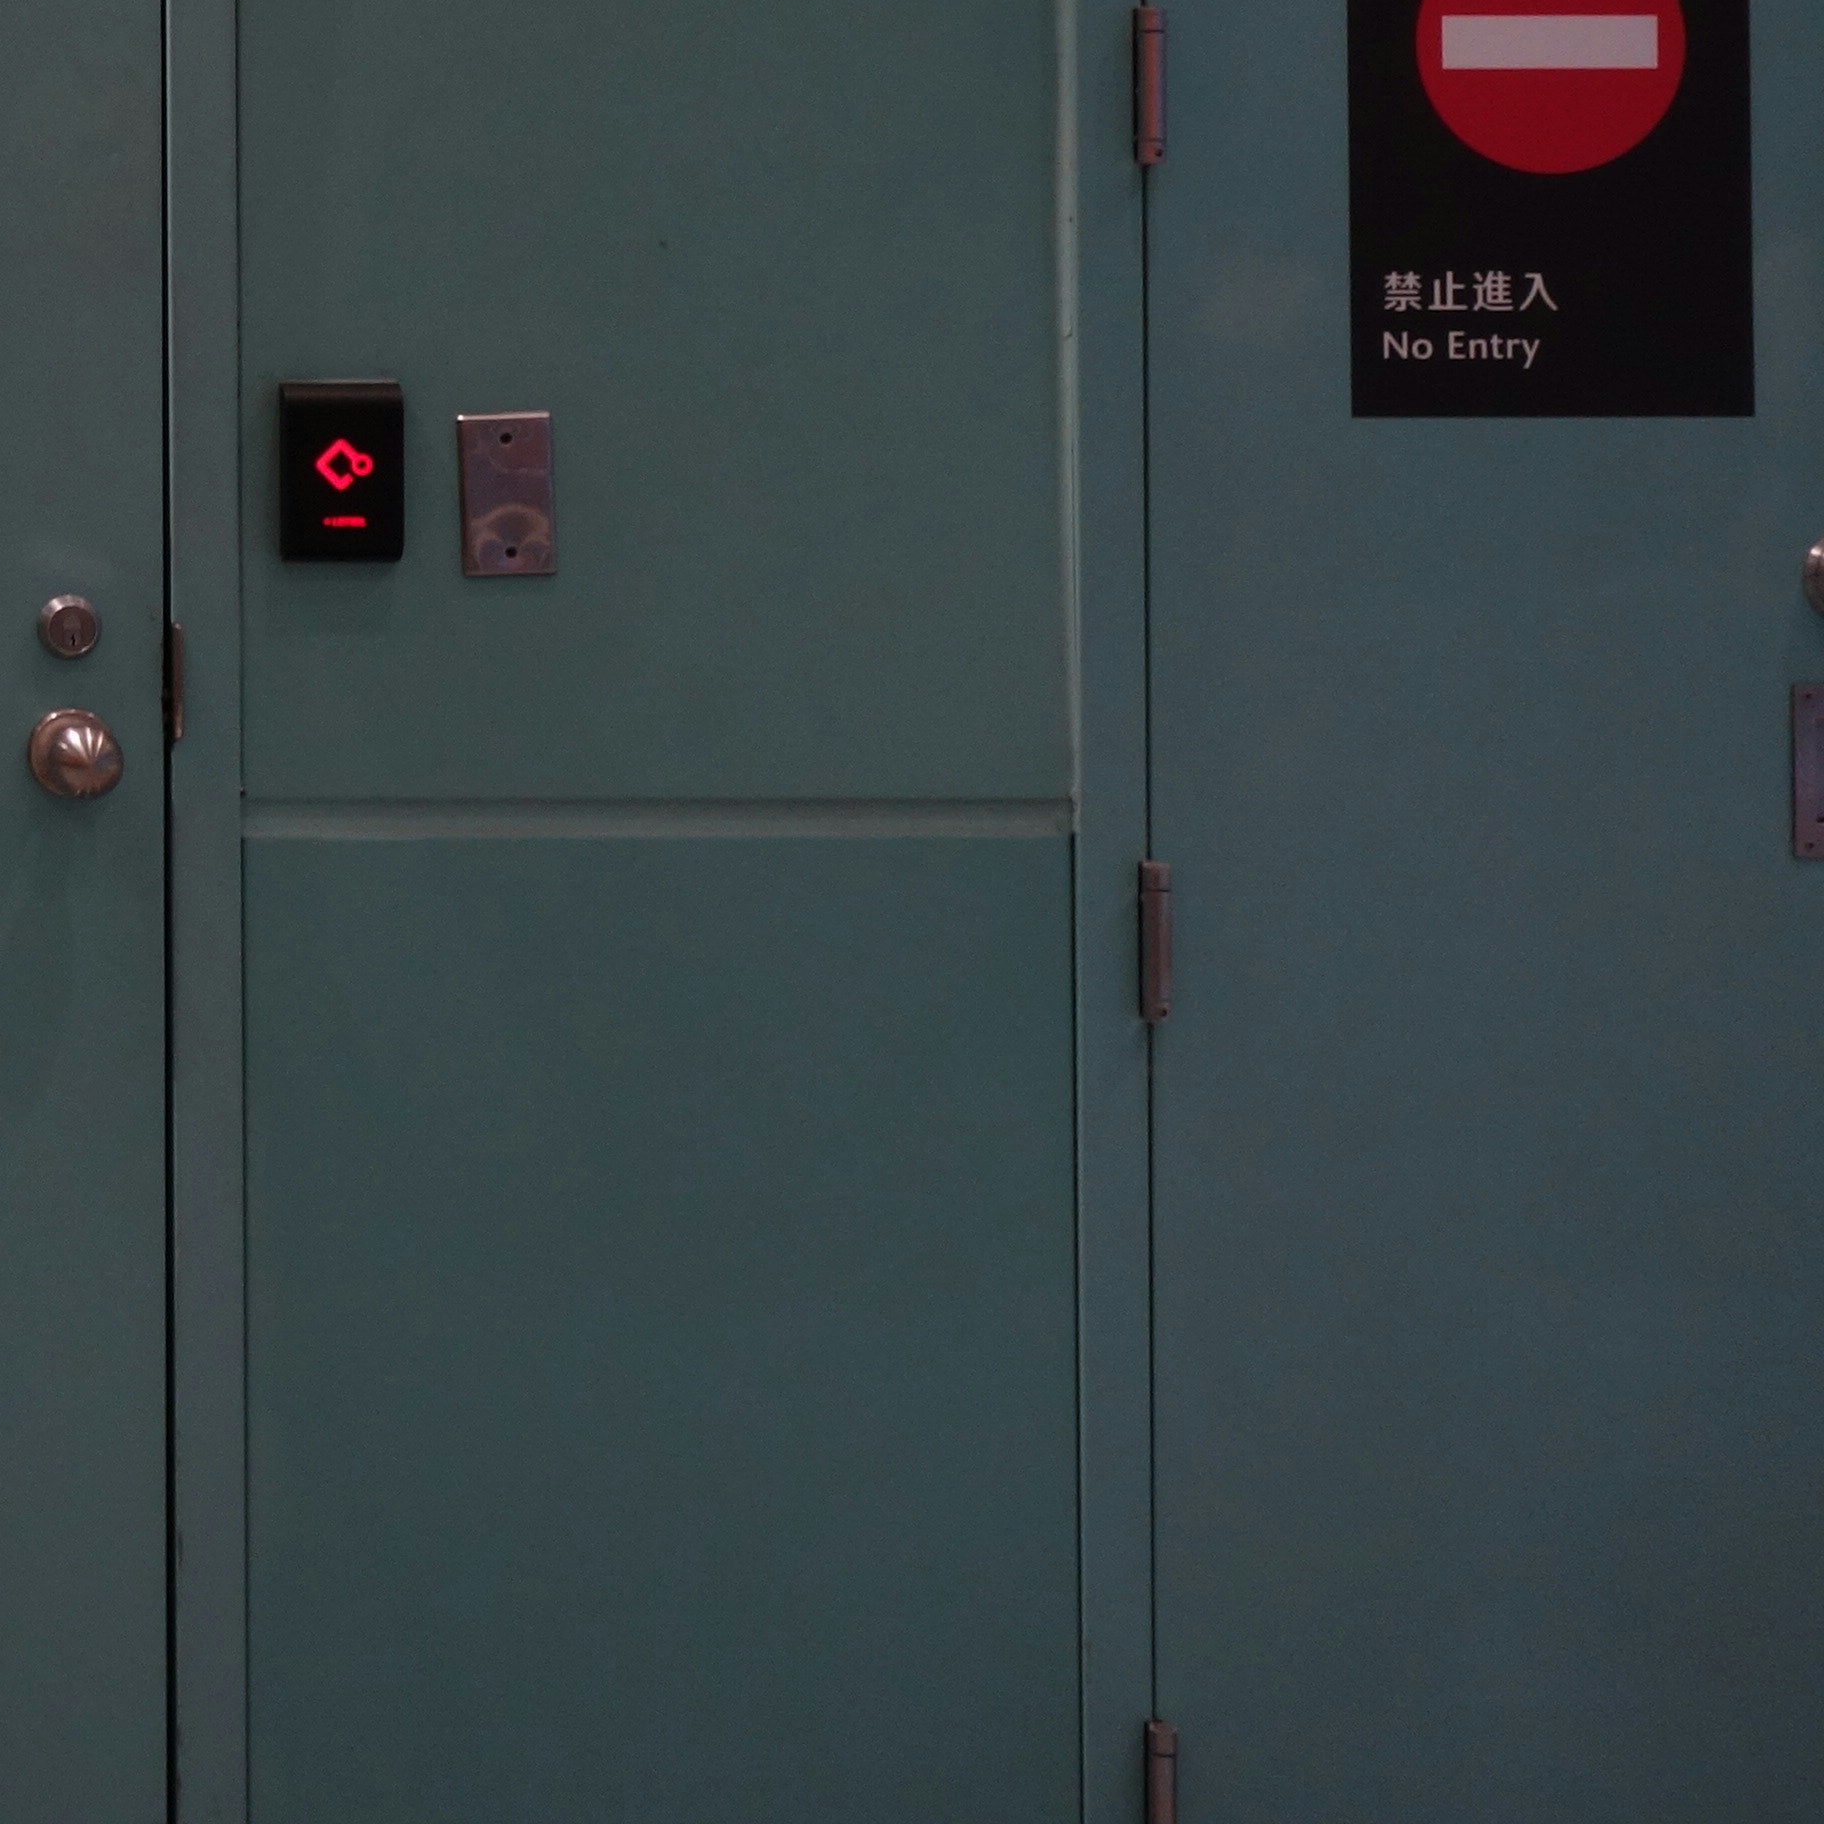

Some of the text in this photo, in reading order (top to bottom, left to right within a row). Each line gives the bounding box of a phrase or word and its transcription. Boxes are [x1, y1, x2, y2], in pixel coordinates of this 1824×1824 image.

[1383, 270, 1558, 313] 禁止進入
[1383, 331, 1541, 369] No Entry
